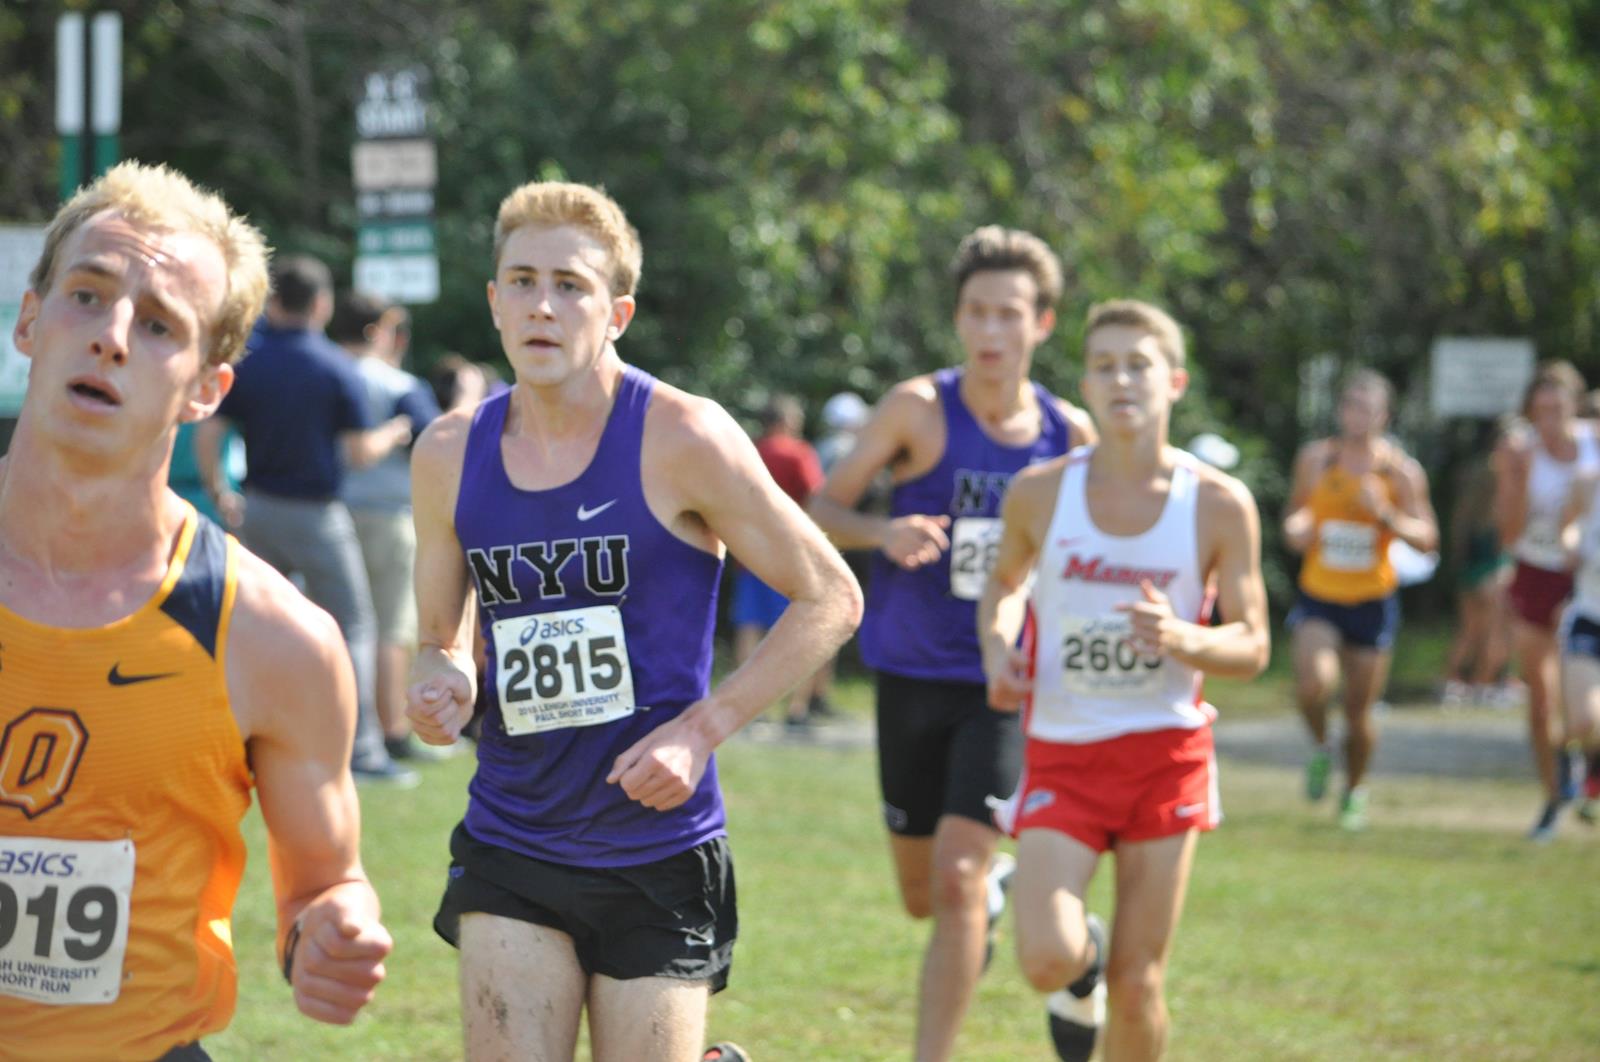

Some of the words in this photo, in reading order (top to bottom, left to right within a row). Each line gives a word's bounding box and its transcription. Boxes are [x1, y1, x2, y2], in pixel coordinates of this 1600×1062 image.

[466, 535, 630, 606] NYU
[504, 636, 623, 703] 2815
[539, 701, 570, 713] LEHIGH
[570, 693, 620, 708] UNIVERSITY
[535, 712, 557, 722] PAUL
[559, 708, 583, 719] SHORT
[585, 706, 604, 716] RUN
[0, 707, 90, 820] Q
[17, 961, 99, 979] UNIVERSITY
[40, 979, 71, 993] RUN
